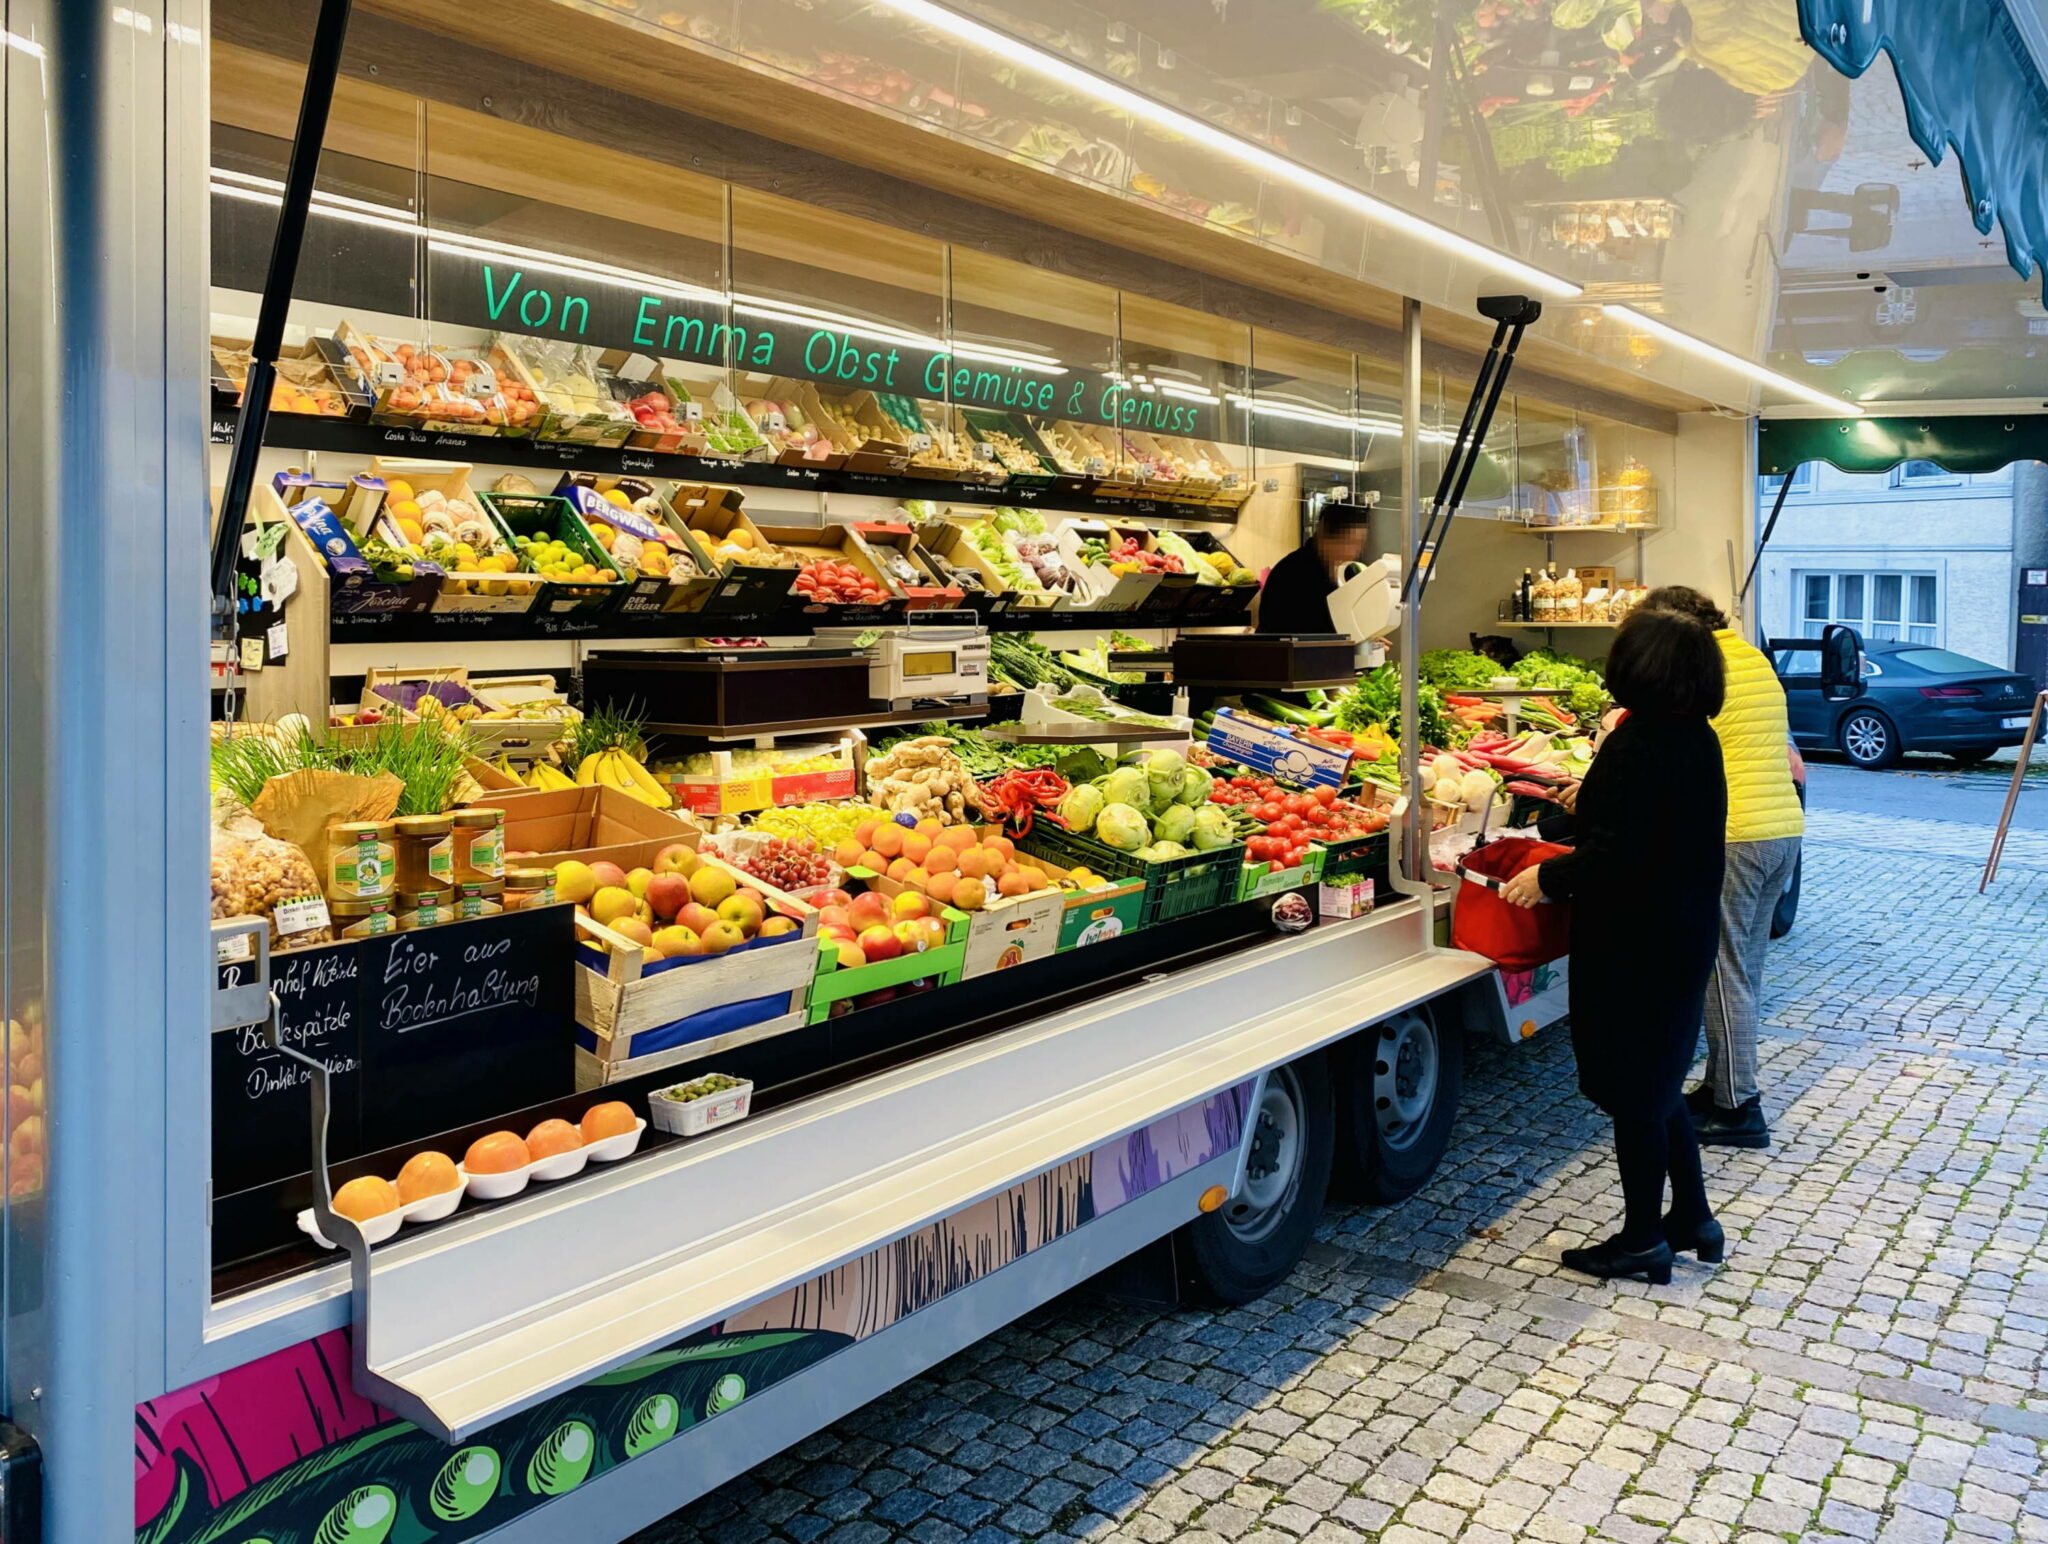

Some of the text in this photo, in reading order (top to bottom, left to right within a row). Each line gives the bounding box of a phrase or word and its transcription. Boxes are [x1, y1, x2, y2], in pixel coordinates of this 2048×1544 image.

[483, 265, 1199, 433] Von Emma Obst Gemüse & Genuss
[384, 430, 467, 447] Costa Rica Ananas
[587, 495, 655, 537] BERGWARE
[623, 603, 660, 612] FLIEGER
[627, 596, 645, 604] DER
[384, 935, 511, 983] Eier aus
[380, 968, 539, 1030] Bodenhaltung
[236, 1001, 350, 1055] Bakspätzle
[246, 1064, 296, 1099] Dinkel
